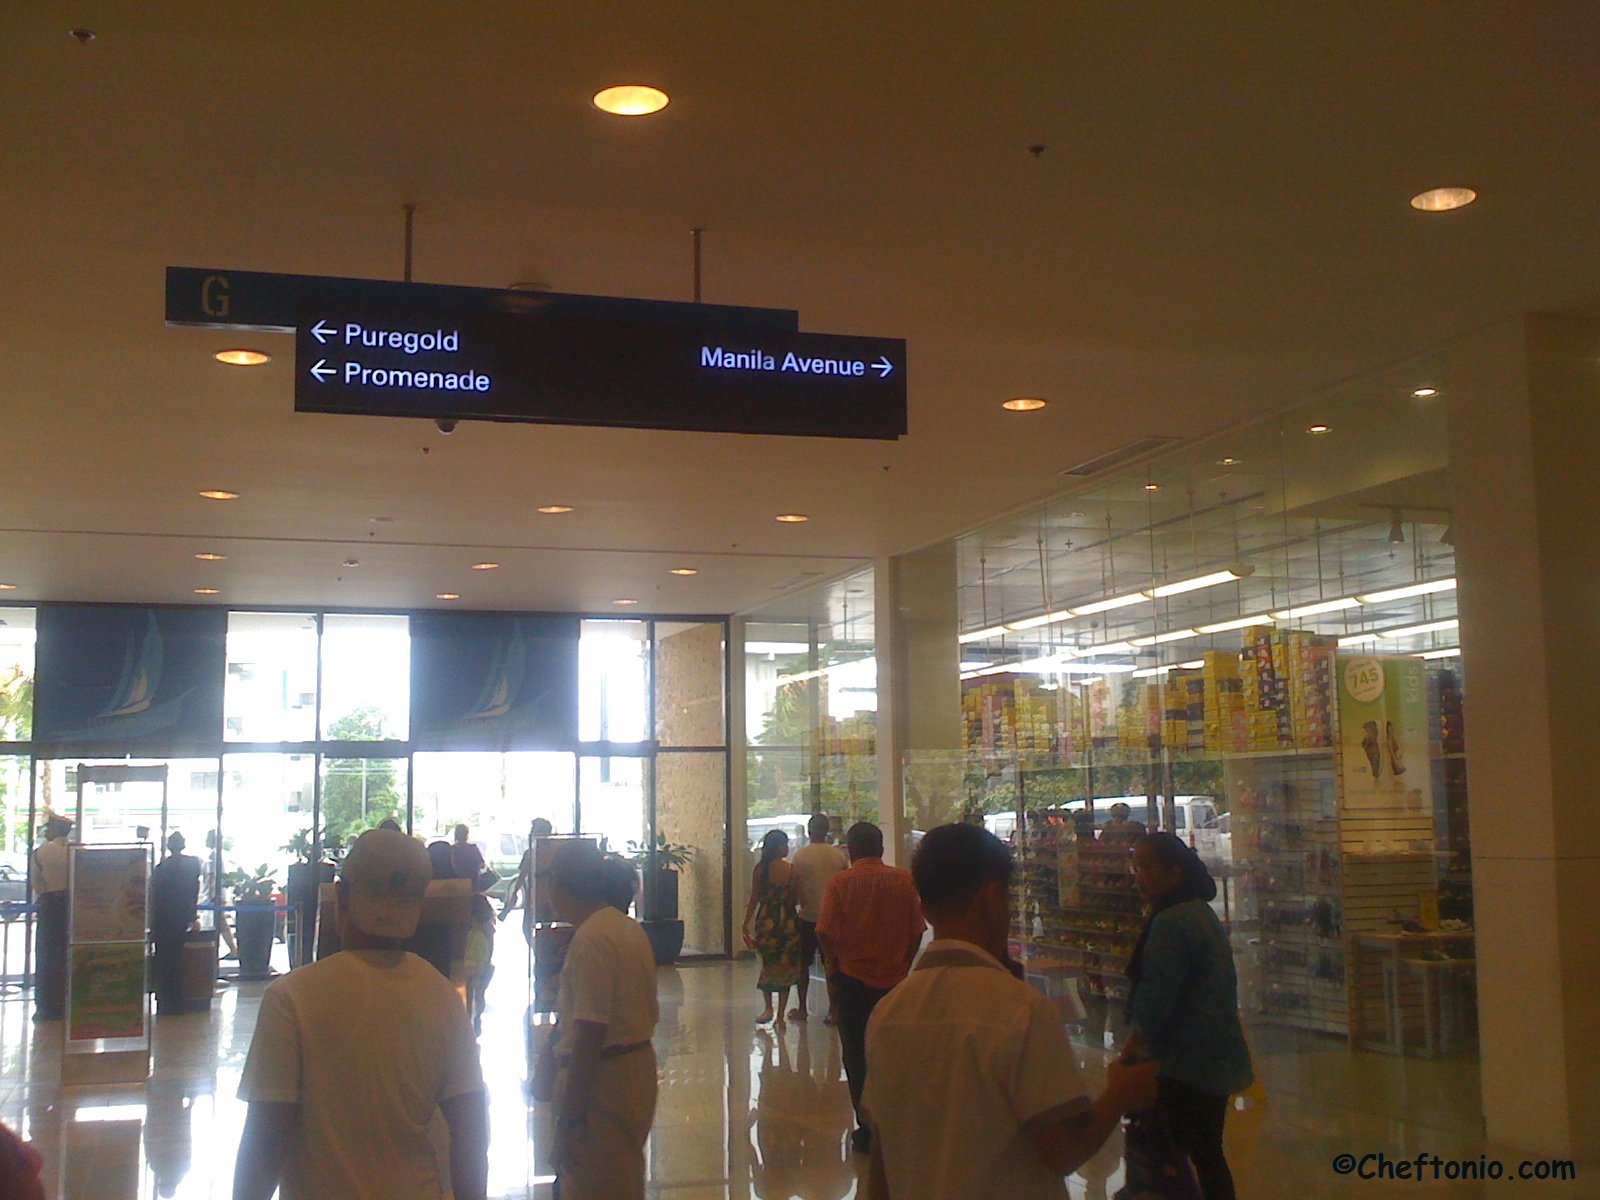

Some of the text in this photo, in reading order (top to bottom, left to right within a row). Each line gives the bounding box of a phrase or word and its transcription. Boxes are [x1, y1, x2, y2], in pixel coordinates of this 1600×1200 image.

[202, 275, 229, 317] G
[345, 323, 459, 354] Puregold
[701, 346, 865, 376] Manila Avenue
[344, 362, 490, 391] Promenade
[1348, 668, 1379, 689] 745
